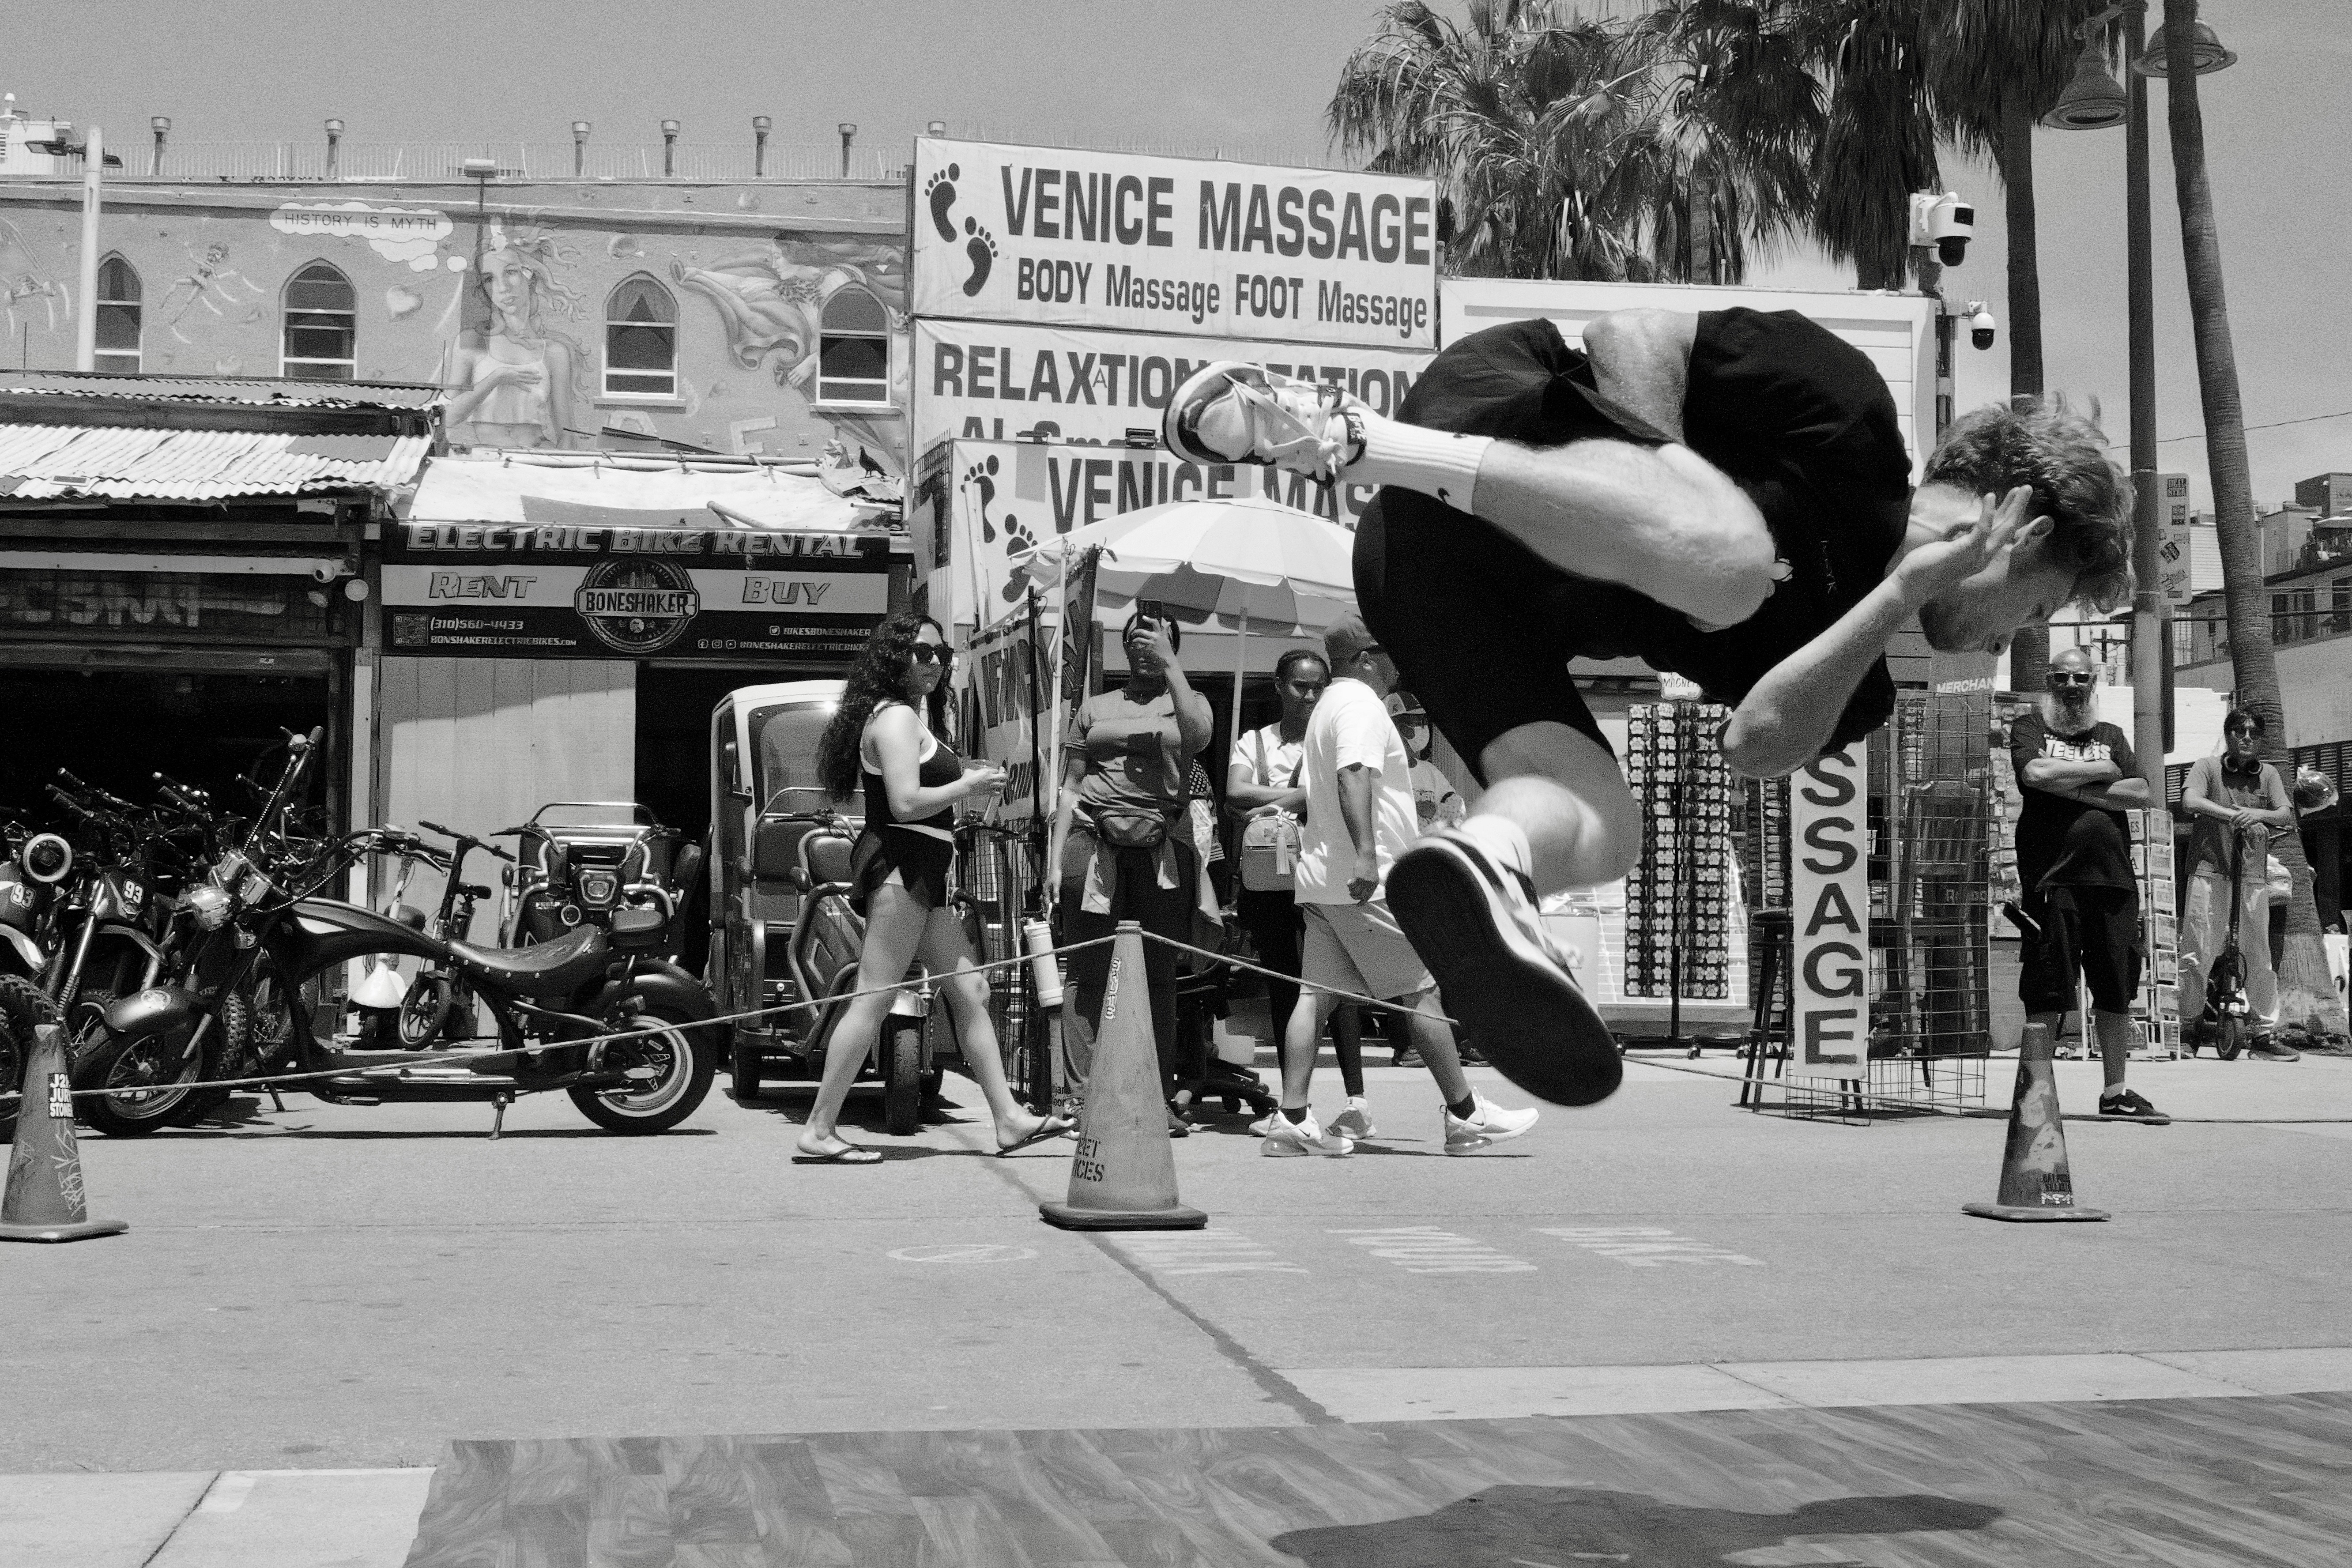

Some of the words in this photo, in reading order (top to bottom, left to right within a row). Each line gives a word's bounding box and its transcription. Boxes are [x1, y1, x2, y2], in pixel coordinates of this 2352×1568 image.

[285, 214, 352, 226] HISTORY
[365, 216, 379, 228] IS
[392, 217, 436, 230] MYTH
[1001, 165, 1174, 248] VENICE
[1199, 180, 1430, 266] MASSAGE
[1017, 257, 1093, 305] BODY
[1106, 264, 1220, 324] Massage
[1235, 273, 1304, 320] FOOT
[1318, 279, 1428, 339] Massage
[407, 525, 602, 551] ELECTRIC
[609, 526, 705, 554] BIKE
[712, 529, 863, 558] RENTAL
[429, 572, 537, 599] RENT
[743, 577, 831, 605] BUY
[586, 592, 689, 616] BONESHAKER
[11, 883, 35, 908] 93
[124, 880, 143, 904] 93
